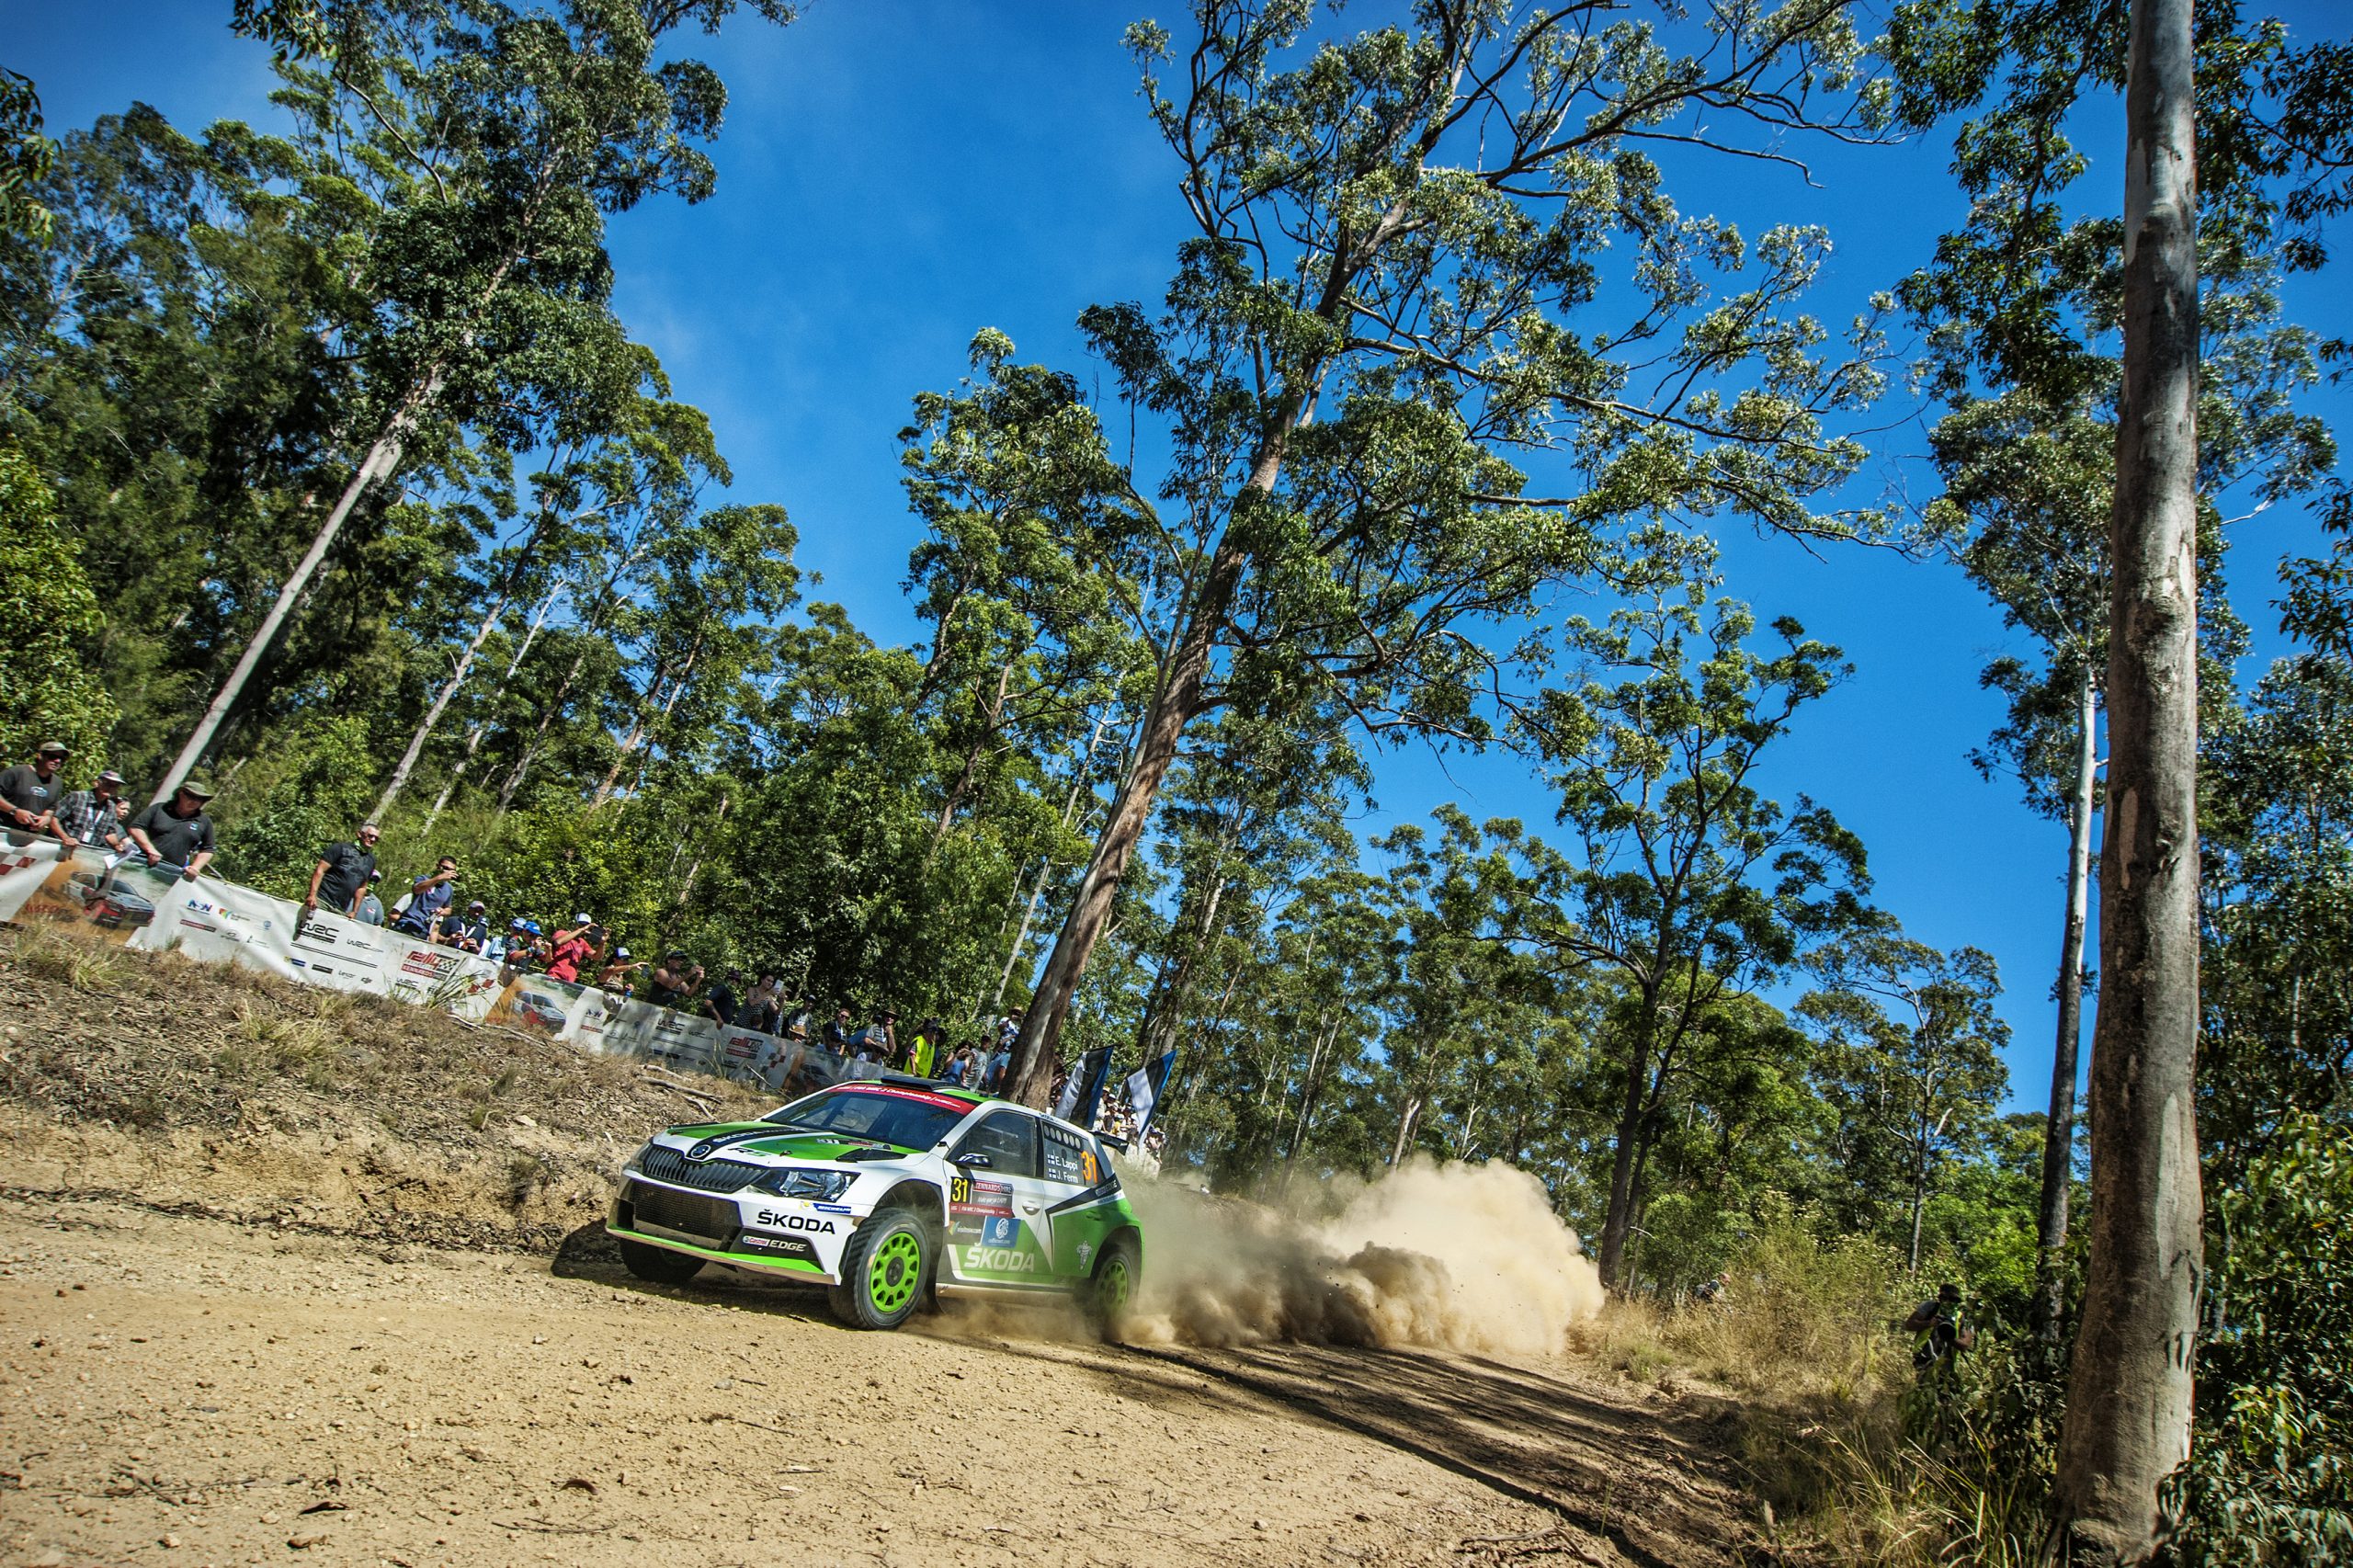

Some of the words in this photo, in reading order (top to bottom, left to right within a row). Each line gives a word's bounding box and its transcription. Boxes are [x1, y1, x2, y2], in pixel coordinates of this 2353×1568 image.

[1055, 1157, 1062, 1166] E.
[1062, 1158, 1077, 1170] Lappi
[1081, 1151, 1097, 1184] 31
[1057, 1170, 1063, 1180] J.
[1063, 1172, 1078, 1183] Ferm
[952, 1178, 968, 1202] 31
[756, 1209, 835, 1234] ŠKODA
[768, 1240, 807, 1252] EDGE
[963, 1242, 1035, 1272] ŠKODA
